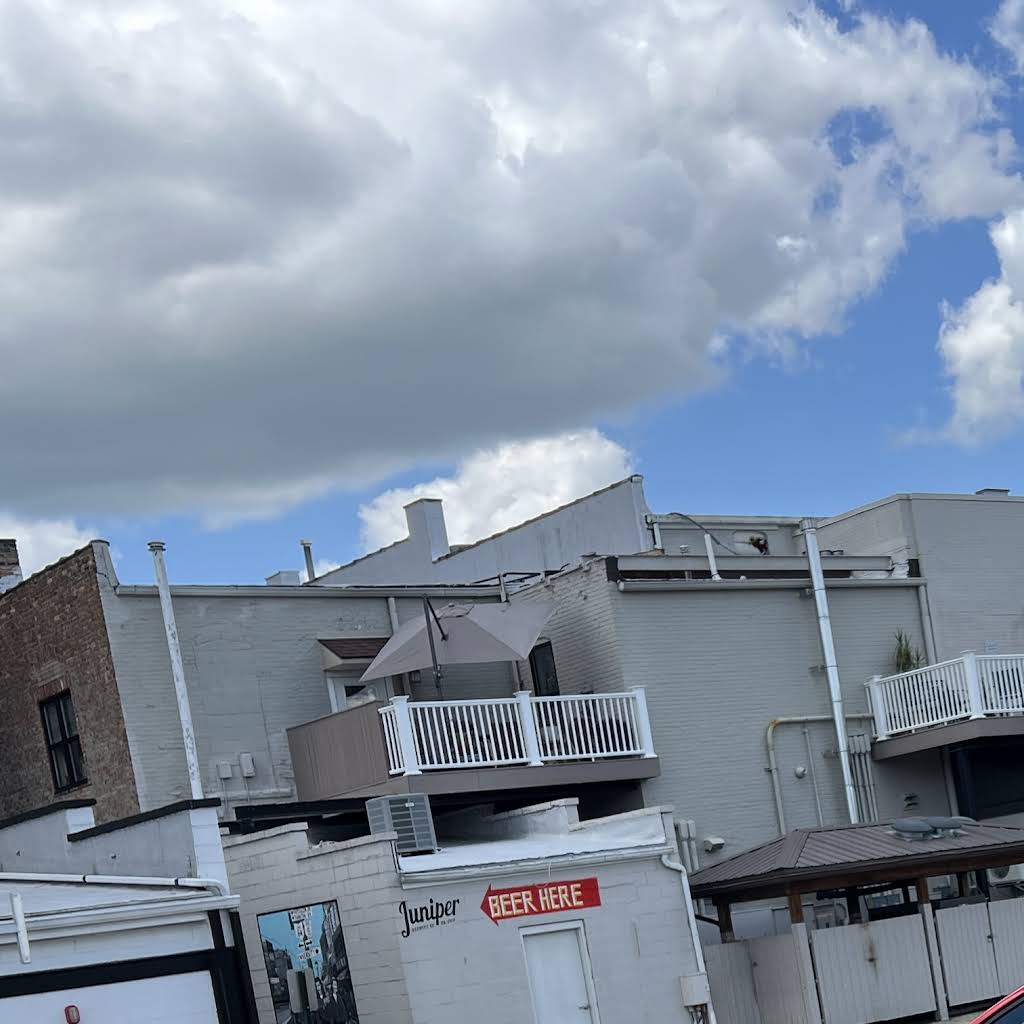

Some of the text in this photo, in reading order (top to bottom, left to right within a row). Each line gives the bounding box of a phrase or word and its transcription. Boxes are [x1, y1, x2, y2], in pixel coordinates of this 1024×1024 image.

[398, 897, 460, 938] Juniper
[488, 883, 584, 919] BEER HERE
